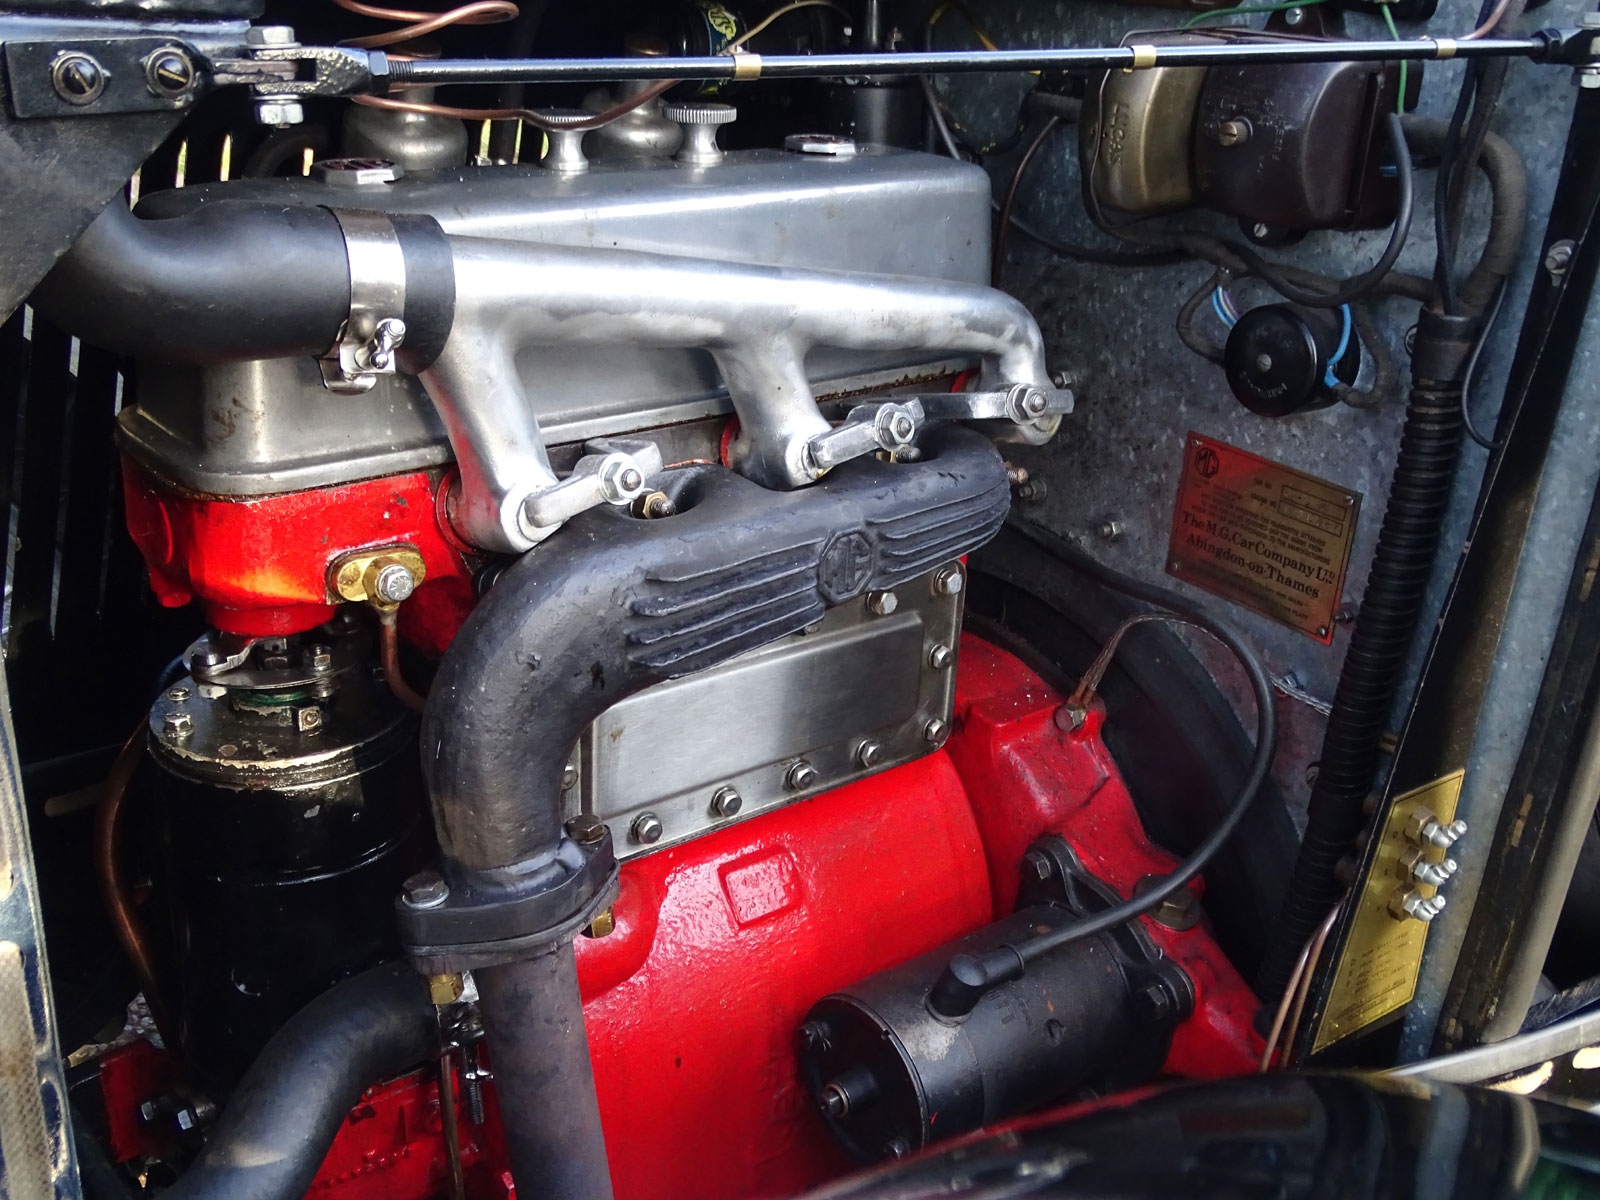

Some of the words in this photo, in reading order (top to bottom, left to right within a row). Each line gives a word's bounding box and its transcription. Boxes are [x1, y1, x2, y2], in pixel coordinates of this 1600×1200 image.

[1107, 101, 1128, 167] LUCAS
[1195, 450, 1219, 478] MG
[1182, 511, 1205, 531] The
[1254, 541, 1315, 579] Company
